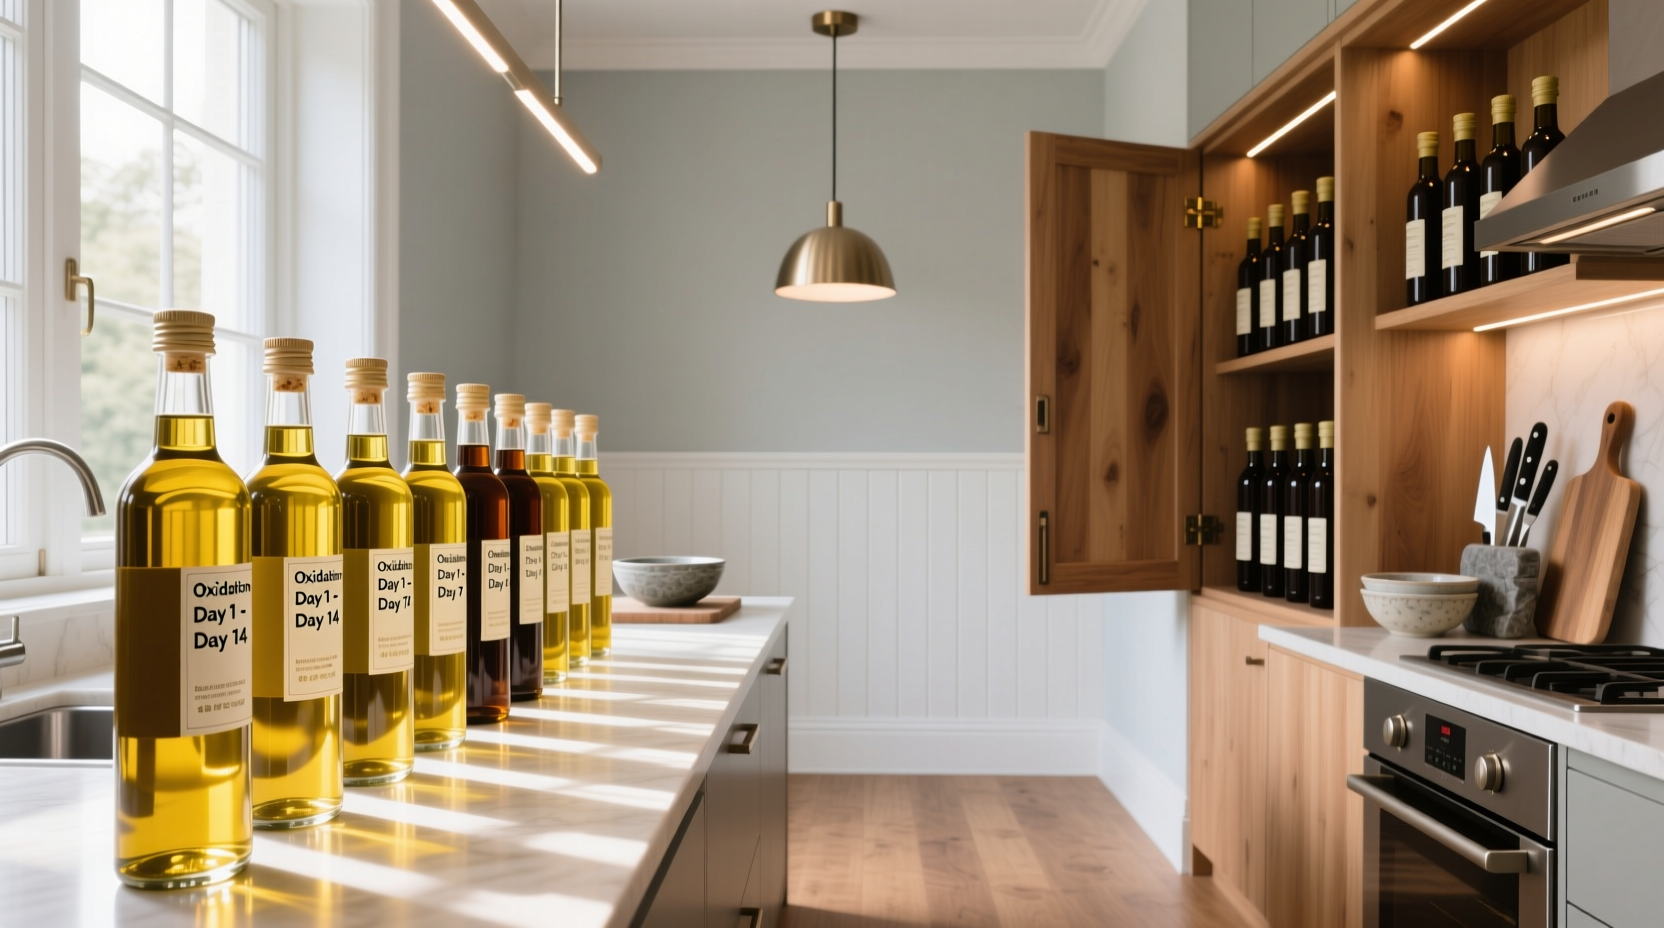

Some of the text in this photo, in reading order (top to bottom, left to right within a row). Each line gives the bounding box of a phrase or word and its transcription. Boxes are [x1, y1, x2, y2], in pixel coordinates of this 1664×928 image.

[437, 569, 456, 581] Day
[378, 578, 400, 593] Day
[488, 578, 504, 592] Day
[295, 590, 323, 608] Day
[378, 597, 401, 614] Day
[193, 606, 227, 626] Day
[229, 603, 236, 620] 1
[295, 609, 340, 632] Day 14
[193, 626, 248, 653] Day 14
